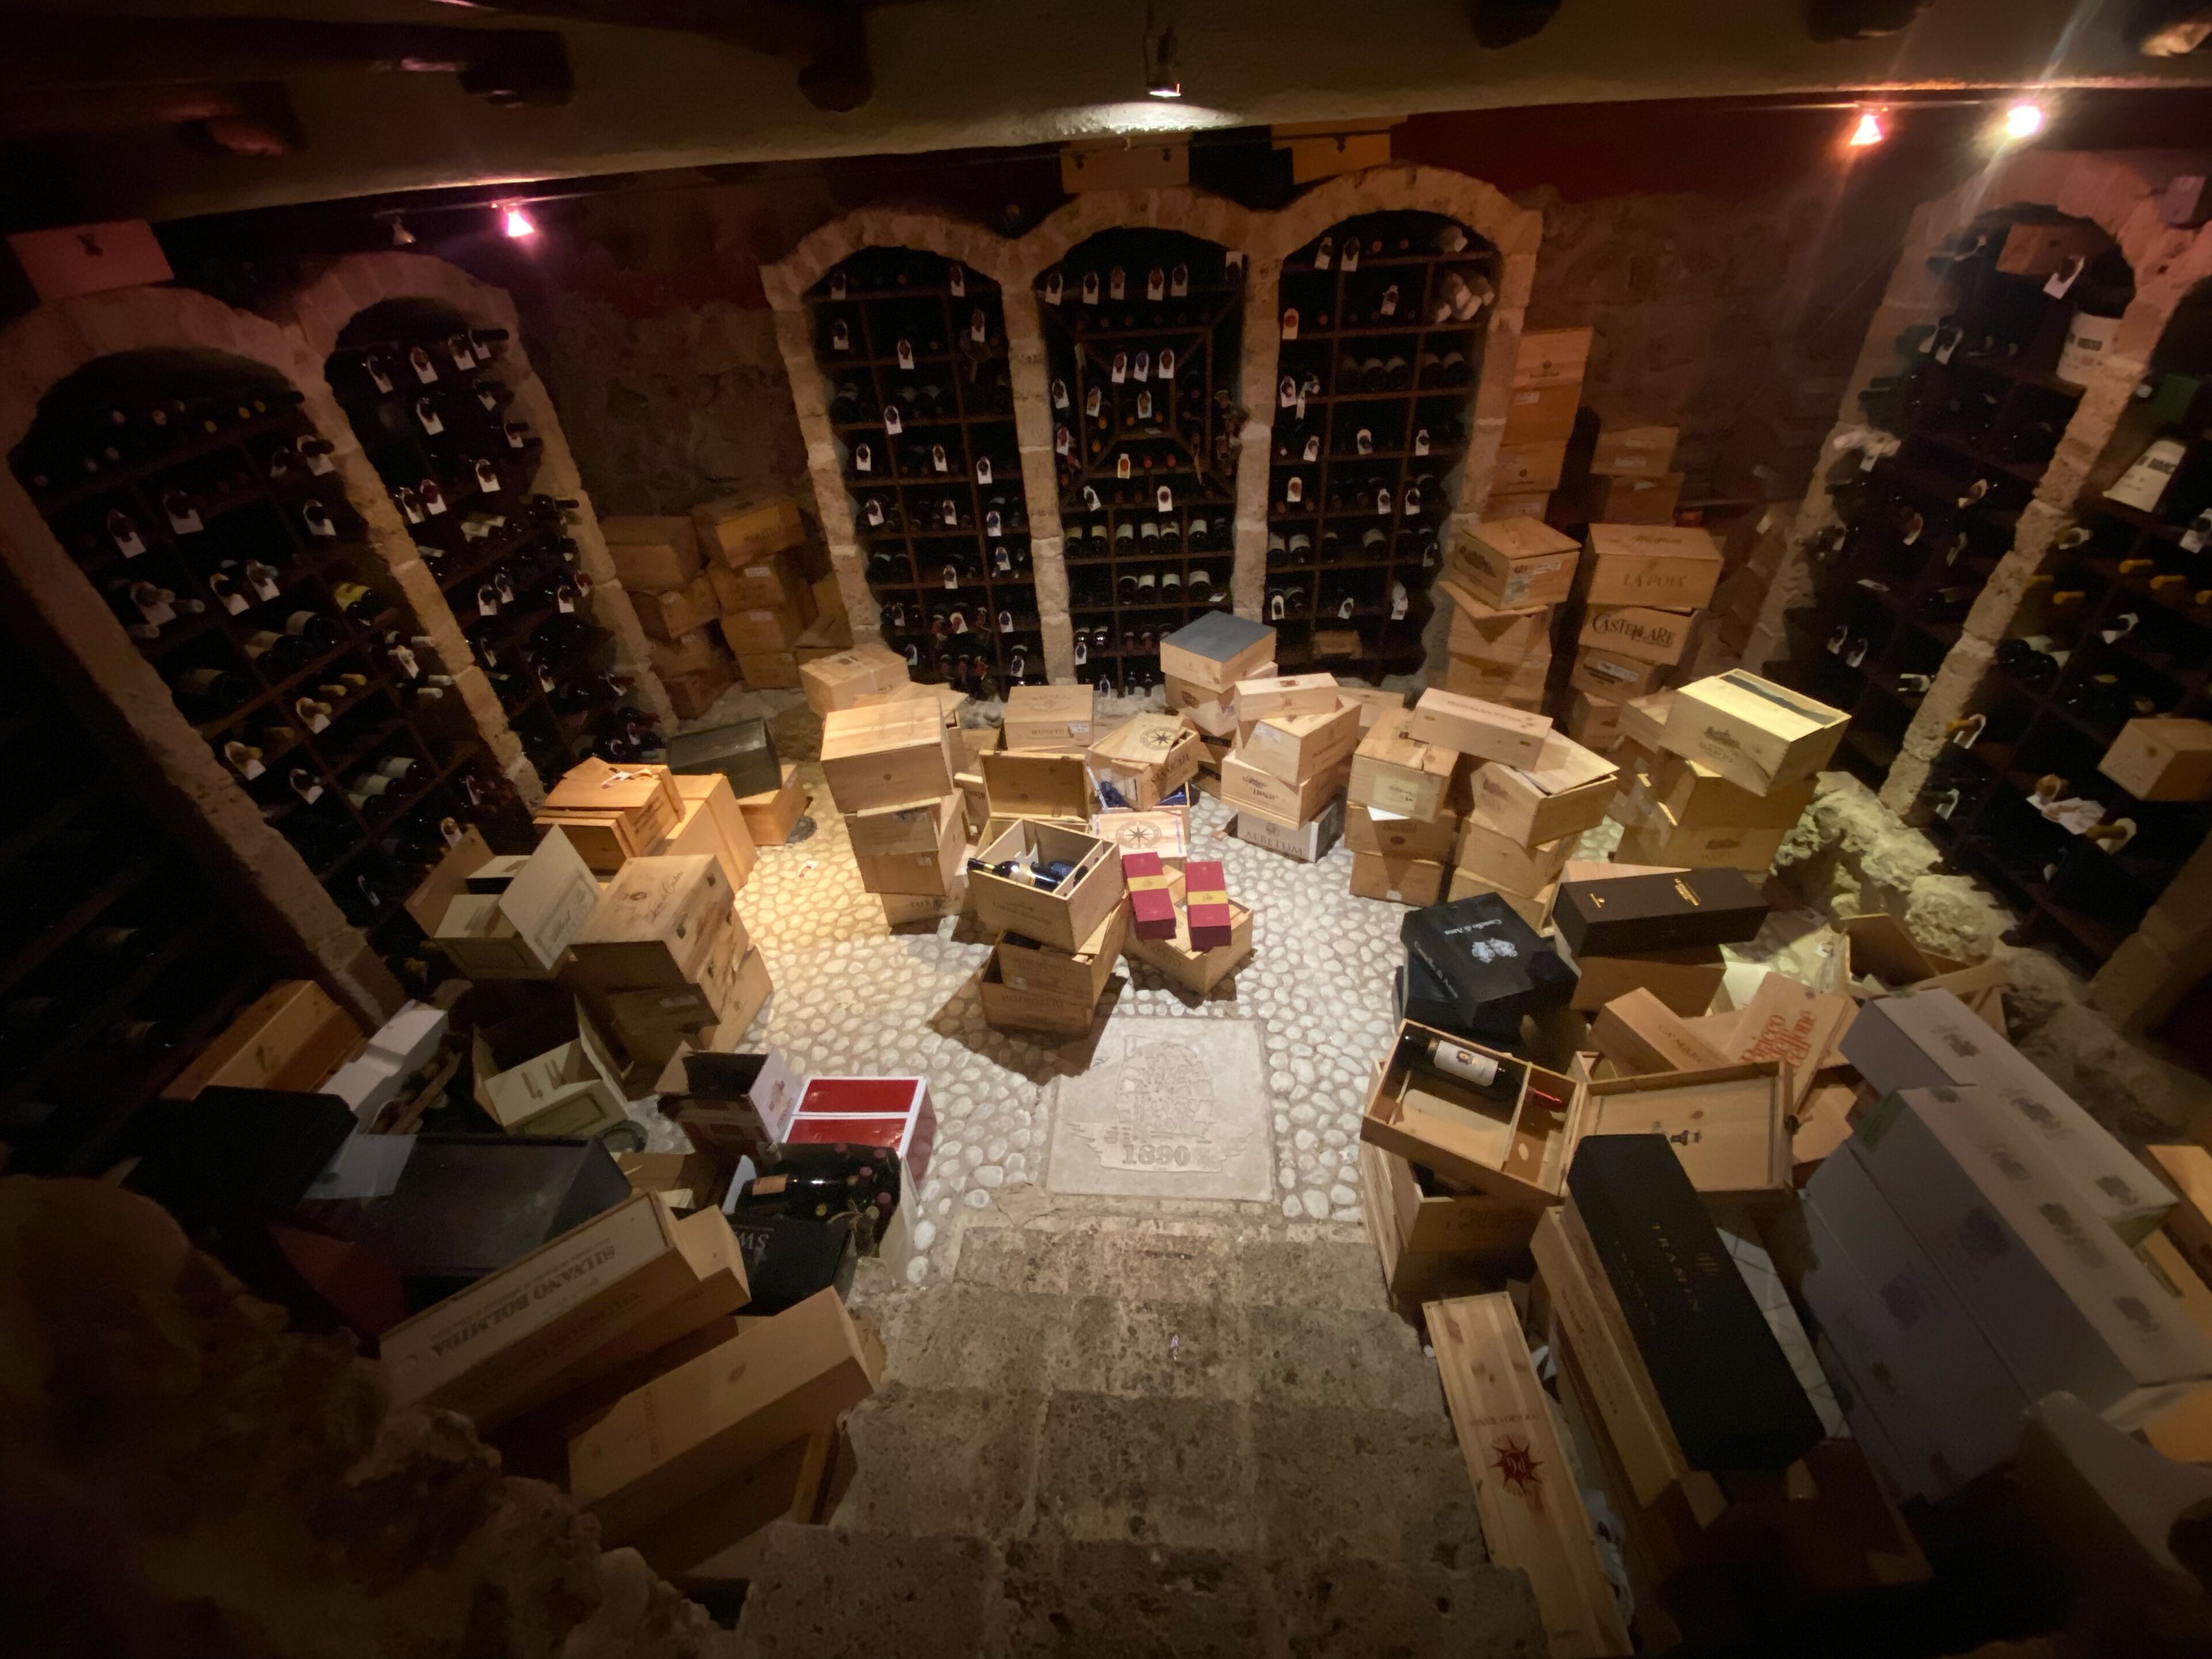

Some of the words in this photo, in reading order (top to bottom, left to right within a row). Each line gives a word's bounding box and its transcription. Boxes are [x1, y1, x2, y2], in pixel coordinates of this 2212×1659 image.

[1245, 830, 1304, 856] ALBETUM
[1122, 1143, 1191, 1166] 1890
[533, 1245, 615, 1300] SILVANO
